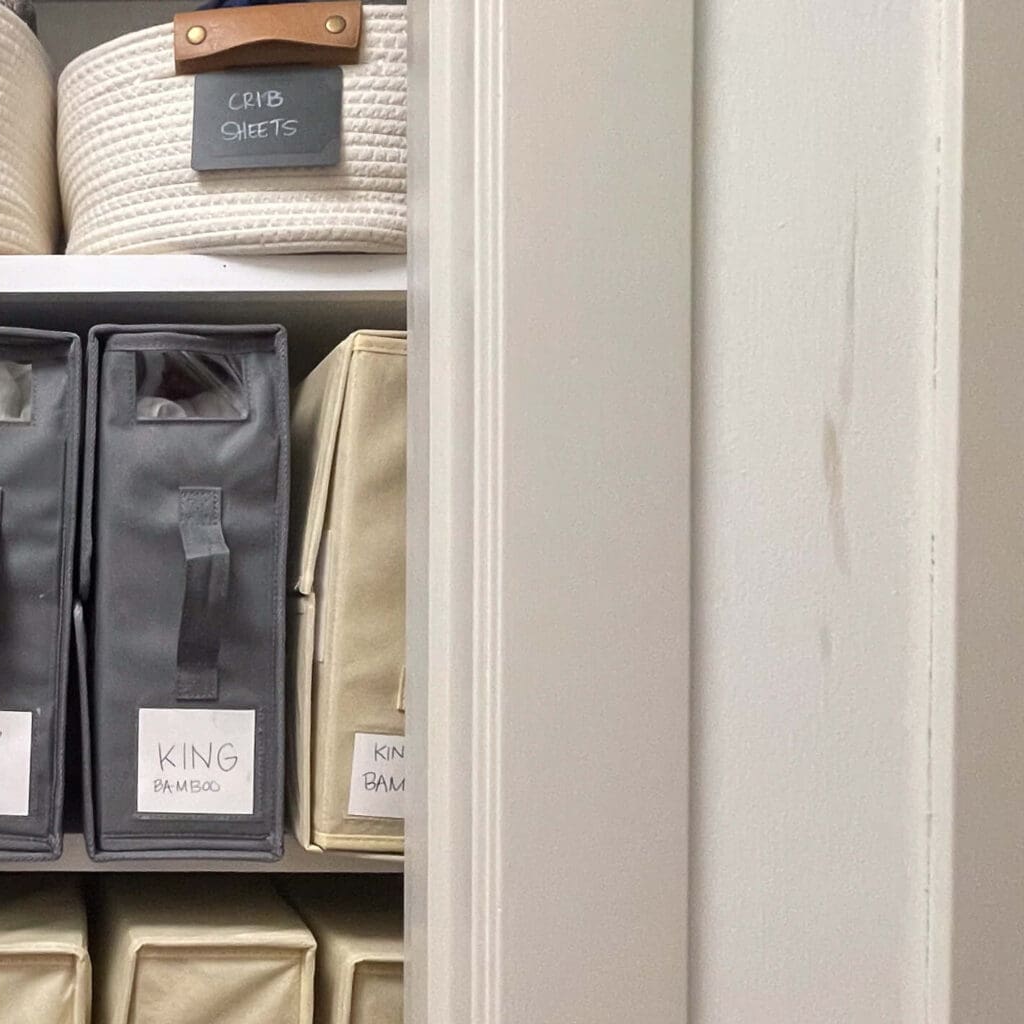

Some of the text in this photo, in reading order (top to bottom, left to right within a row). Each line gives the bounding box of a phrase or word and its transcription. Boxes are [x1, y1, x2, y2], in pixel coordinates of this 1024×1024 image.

[228, 89, 284, 111] CRIB
[221, 118, 299, 142] SHEETS
[157, 741, 238, 773] KING
[374, 741, 405, 761] KIN
[153, 778, 221, 794] BAMBOO
[362, 771, 405, 793] BAM
